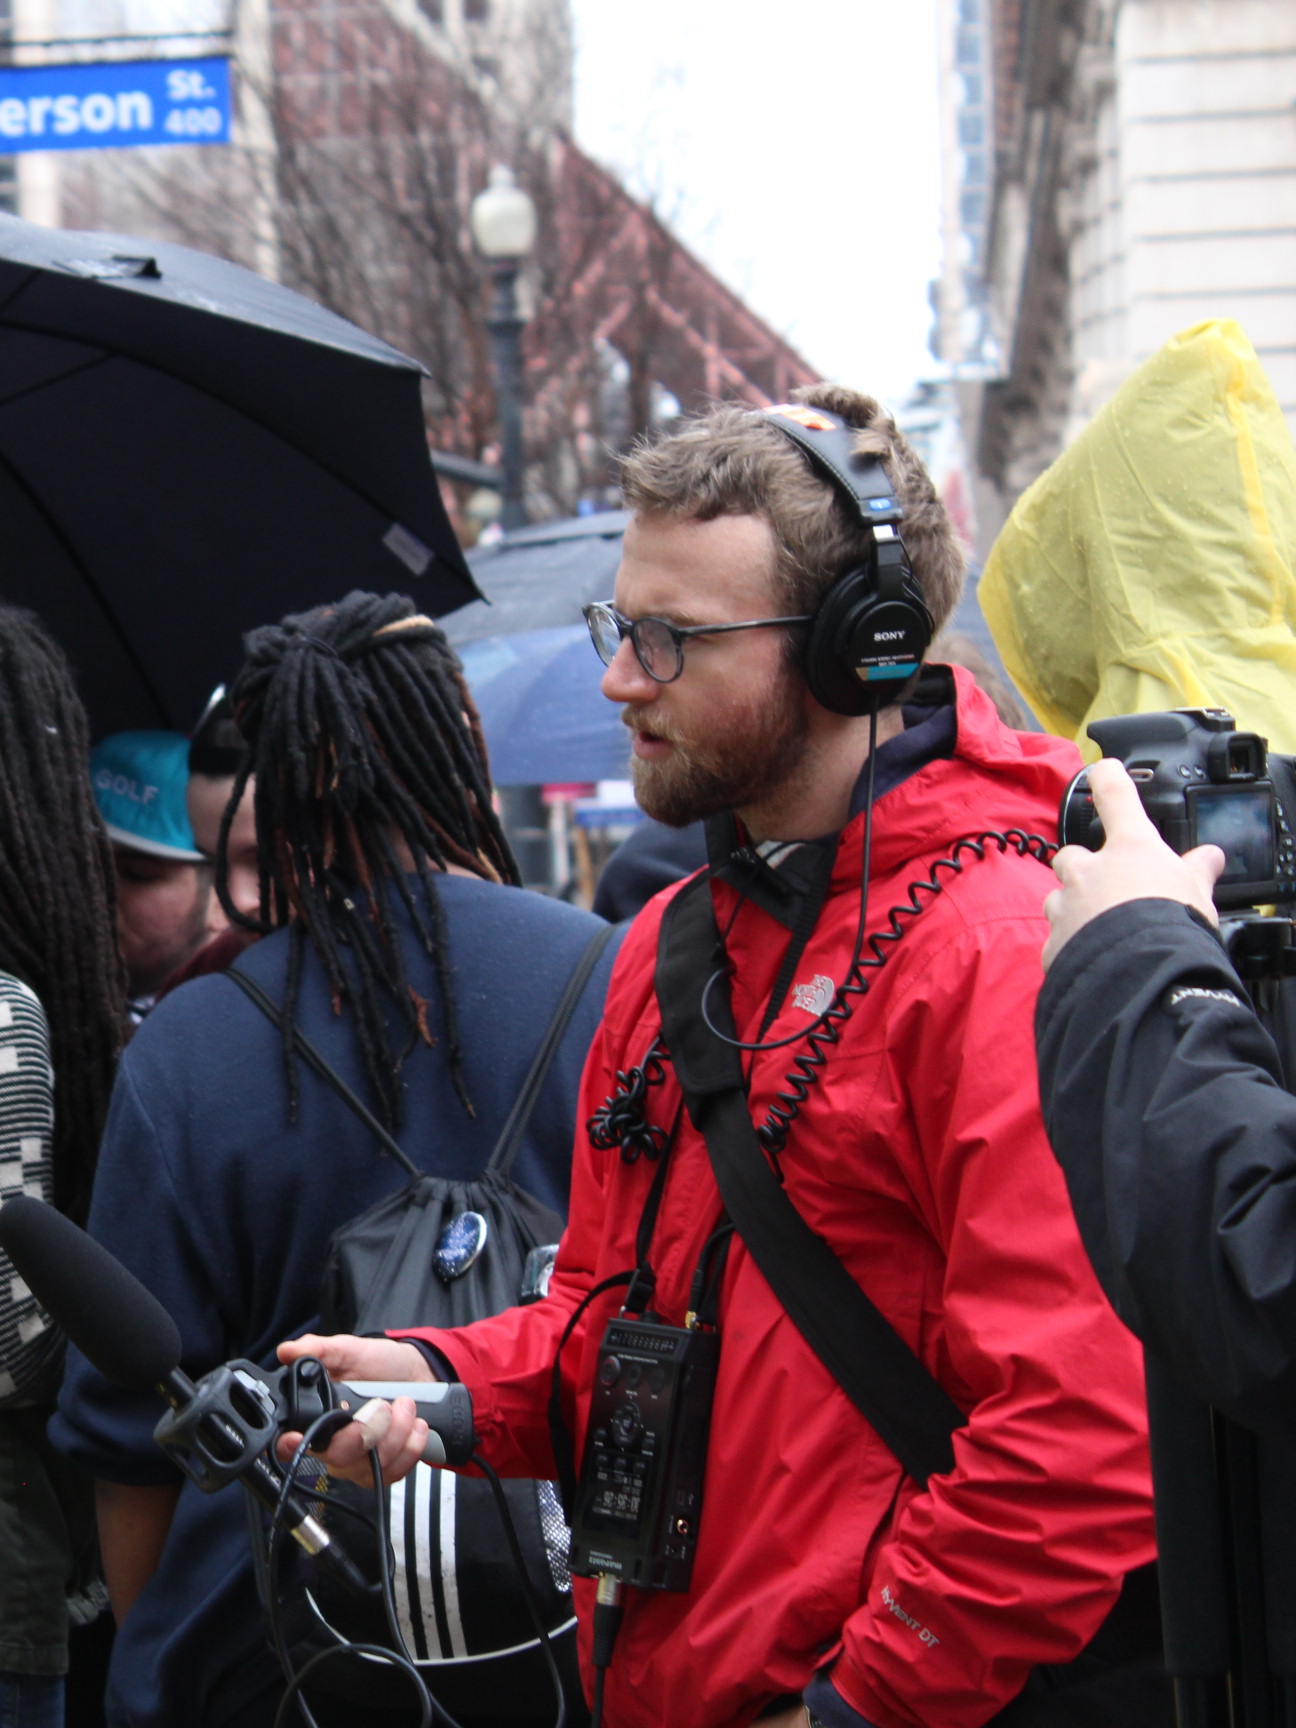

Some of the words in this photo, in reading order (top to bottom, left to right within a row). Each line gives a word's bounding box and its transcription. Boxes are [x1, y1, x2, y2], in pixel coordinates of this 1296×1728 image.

[166, 70, 216, 101] St.
[164, 107, 222, 136] 400
[873, 630, 906, 642] SONY
[96, 769, 160, 806] GOLF
[918, 1627, 941, 1648] DT
